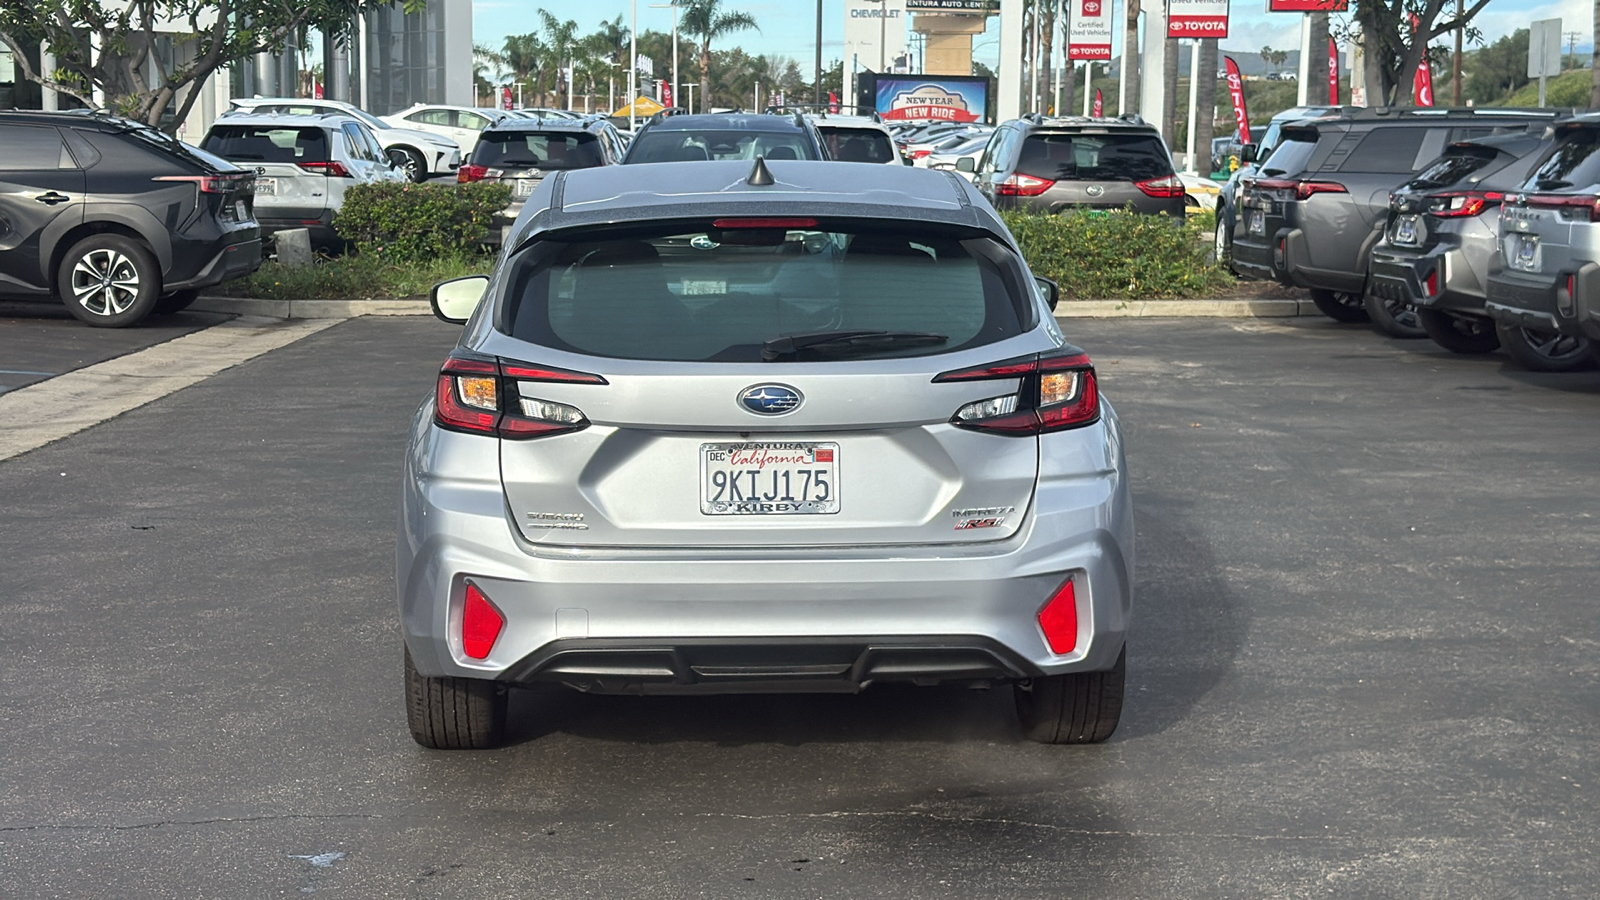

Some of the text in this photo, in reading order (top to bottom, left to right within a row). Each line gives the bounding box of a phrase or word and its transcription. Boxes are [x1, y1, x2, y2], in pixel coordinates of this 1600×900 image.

[850, 9, 901, 19] CHEVROLET
[1184, 21, 1226, 31] TOYOTA
[1086, 29, 1111, 37] Vehicles
[1080, 47, 1110, 56] TOYOTA
[905, 96, 954, 105] NEW YEAR
[904, 107, 956, 119] NEW RIDE
[709, 452, 726, 461] DEC
[730, 449, 814, 470] California
[711, 470, 830, 502] 9KIJ175
[736, 503, 803, 512] KIRBY
[951, 505, 1017, 518] IMPREZA
[526, 511, 585, 521] SUBARU
